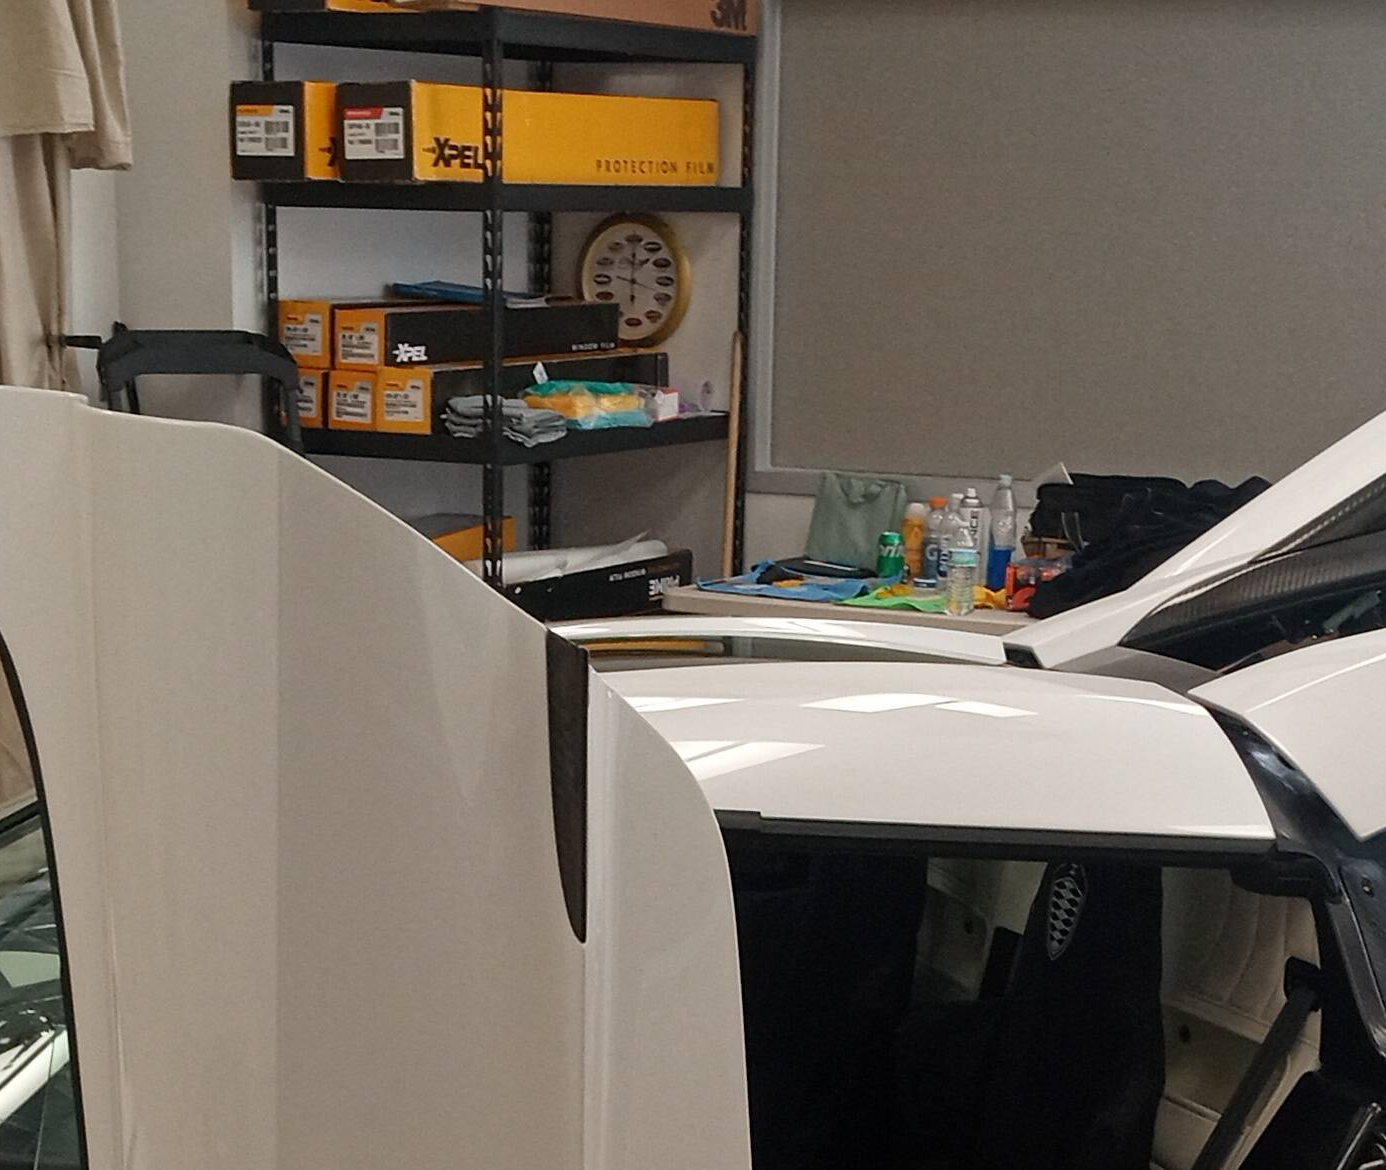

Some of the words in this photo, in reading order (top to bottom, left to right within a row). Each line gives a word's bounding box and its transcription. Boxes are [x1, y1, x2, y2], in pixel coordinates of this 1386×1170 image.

[710, 0, 747, 31] 3M
[428, 137, 487, 169] XPEL
[595, 159, 678, 174] PROTECTION
[394, 343, 428, 363] XPEL
